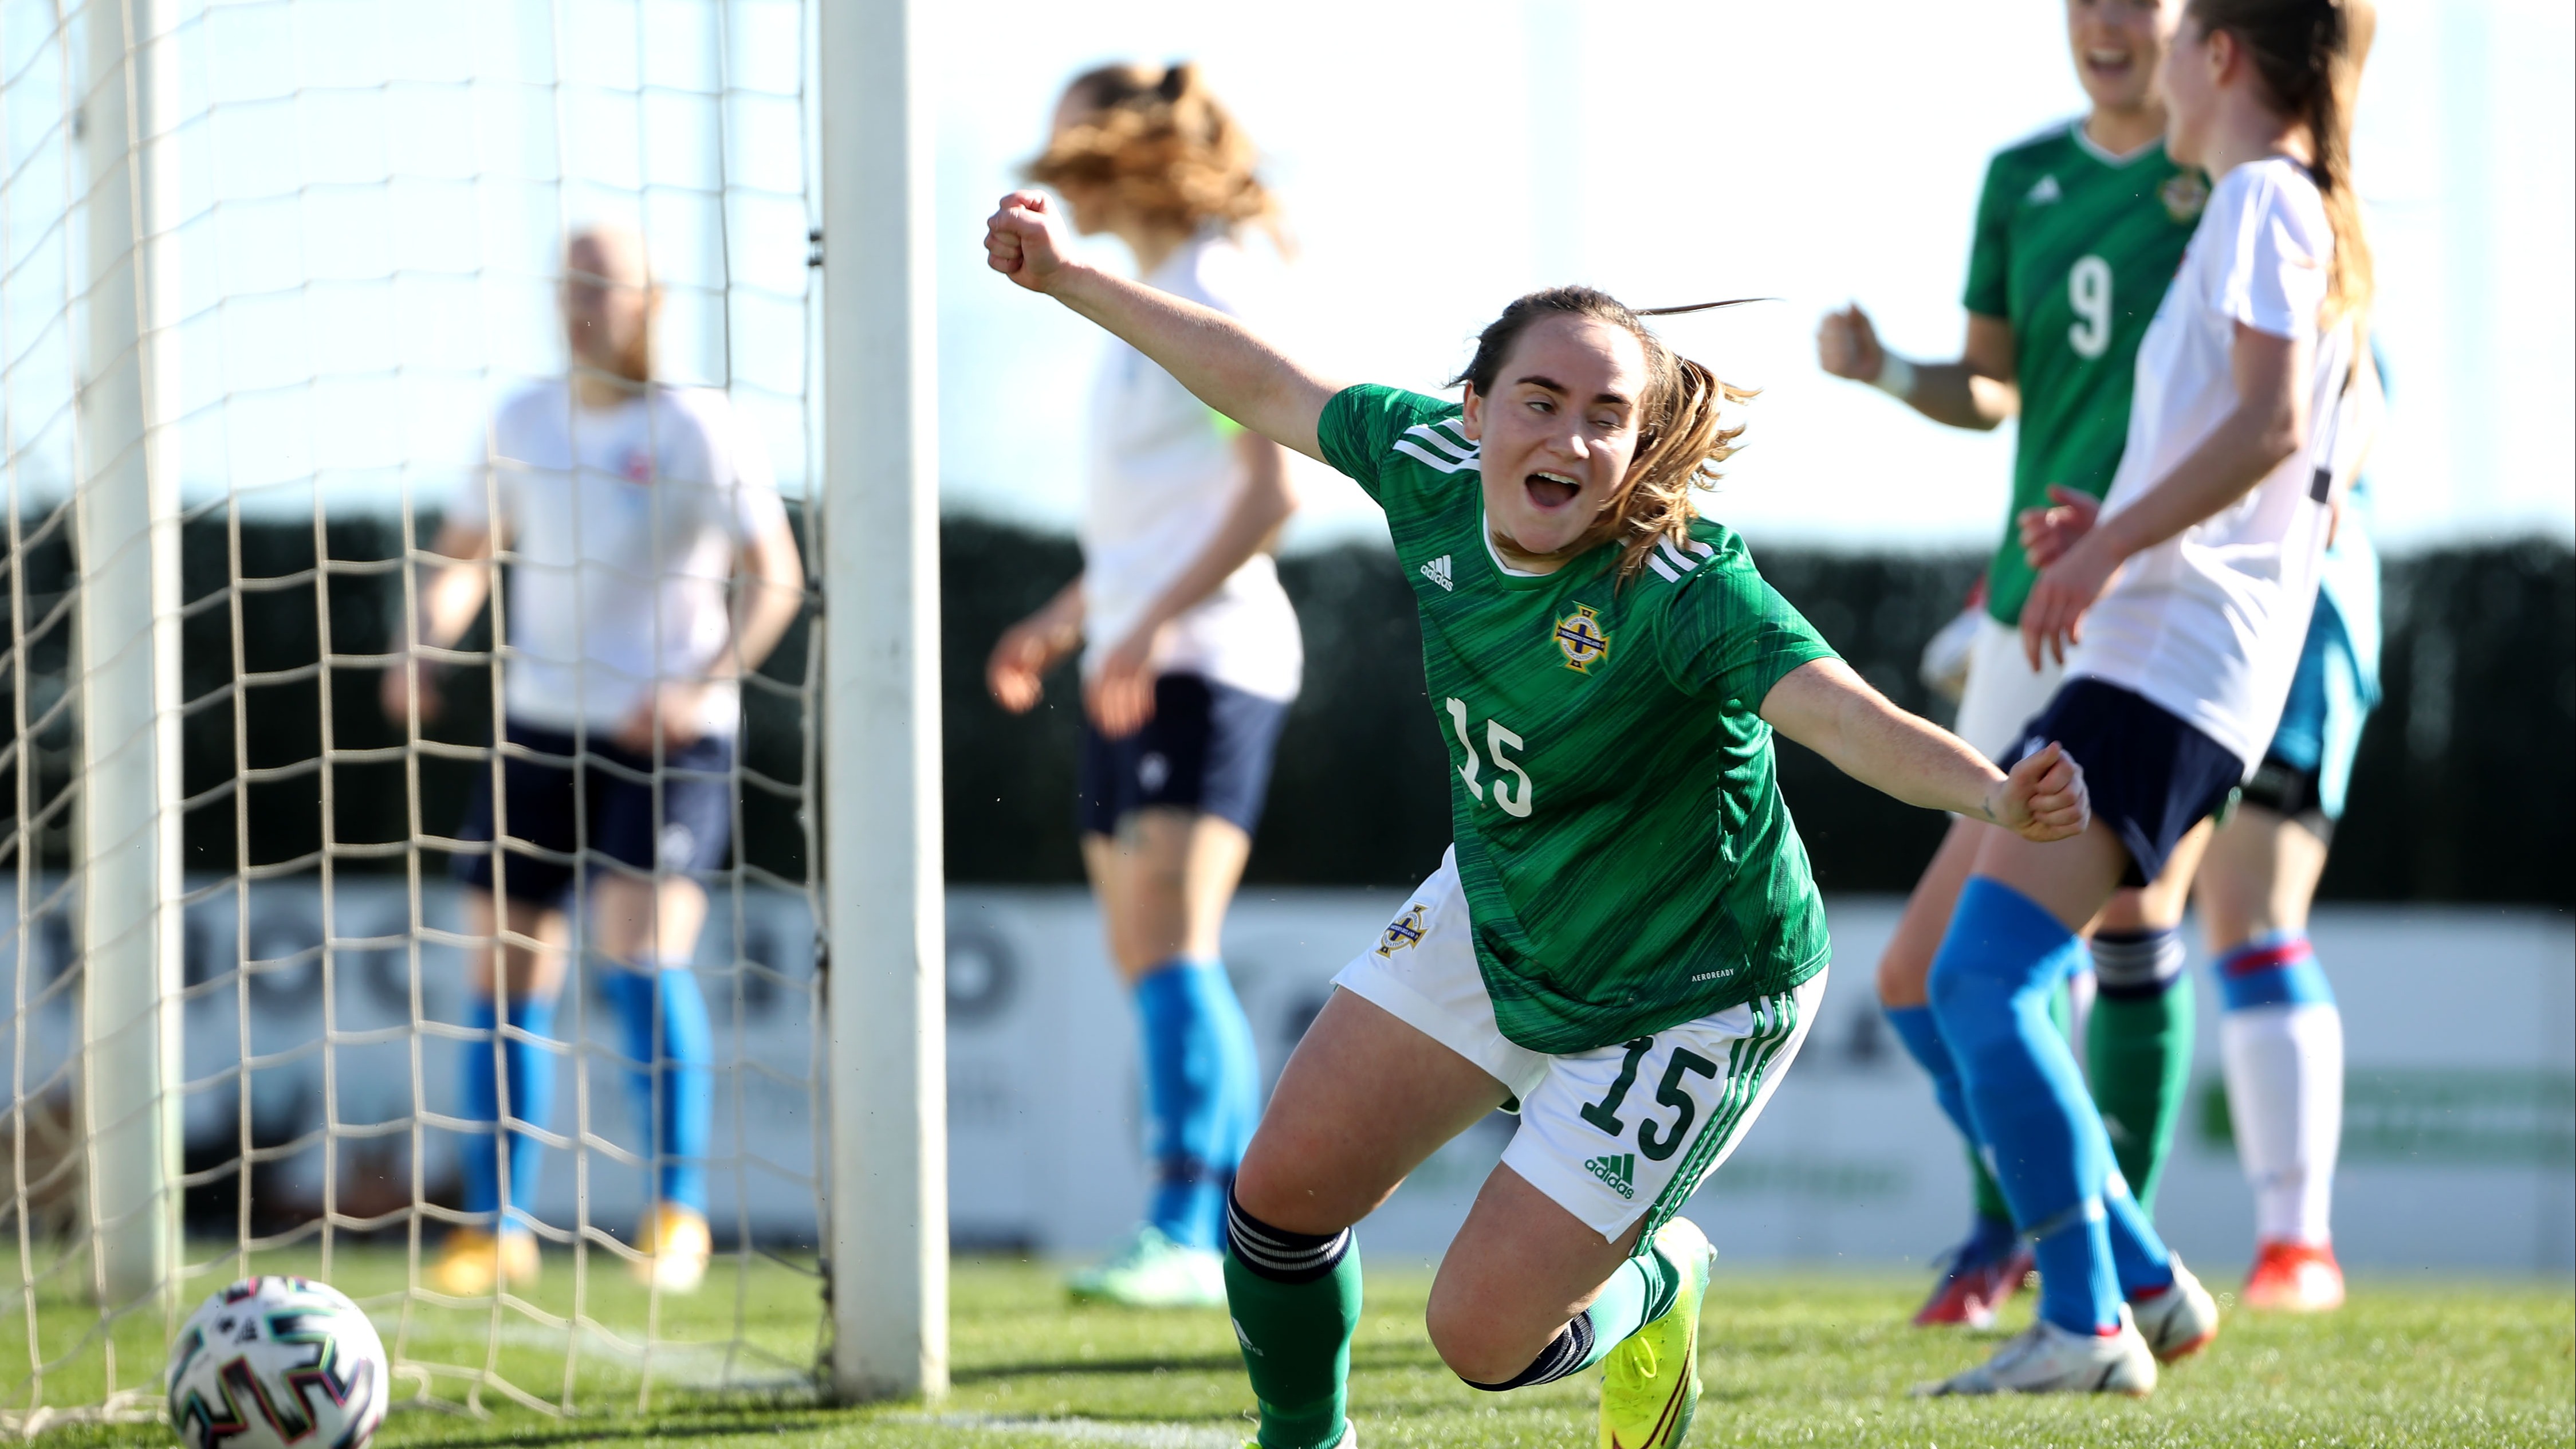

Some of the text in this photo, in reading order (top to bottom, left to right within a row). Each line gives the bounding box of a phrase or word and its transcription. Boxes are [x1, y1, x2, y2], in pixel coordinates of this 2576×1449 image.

[2067, 254, 2113, 360] 9
[1421, 564, 1453, 592] adidas
[1446, 696, 1532, 818] 15
[1692, 968, 1734, 982] AEROREADY
[1580, 1036, 1718, 1161] 15
[1584, 1159, 1634, 1200] adidas
